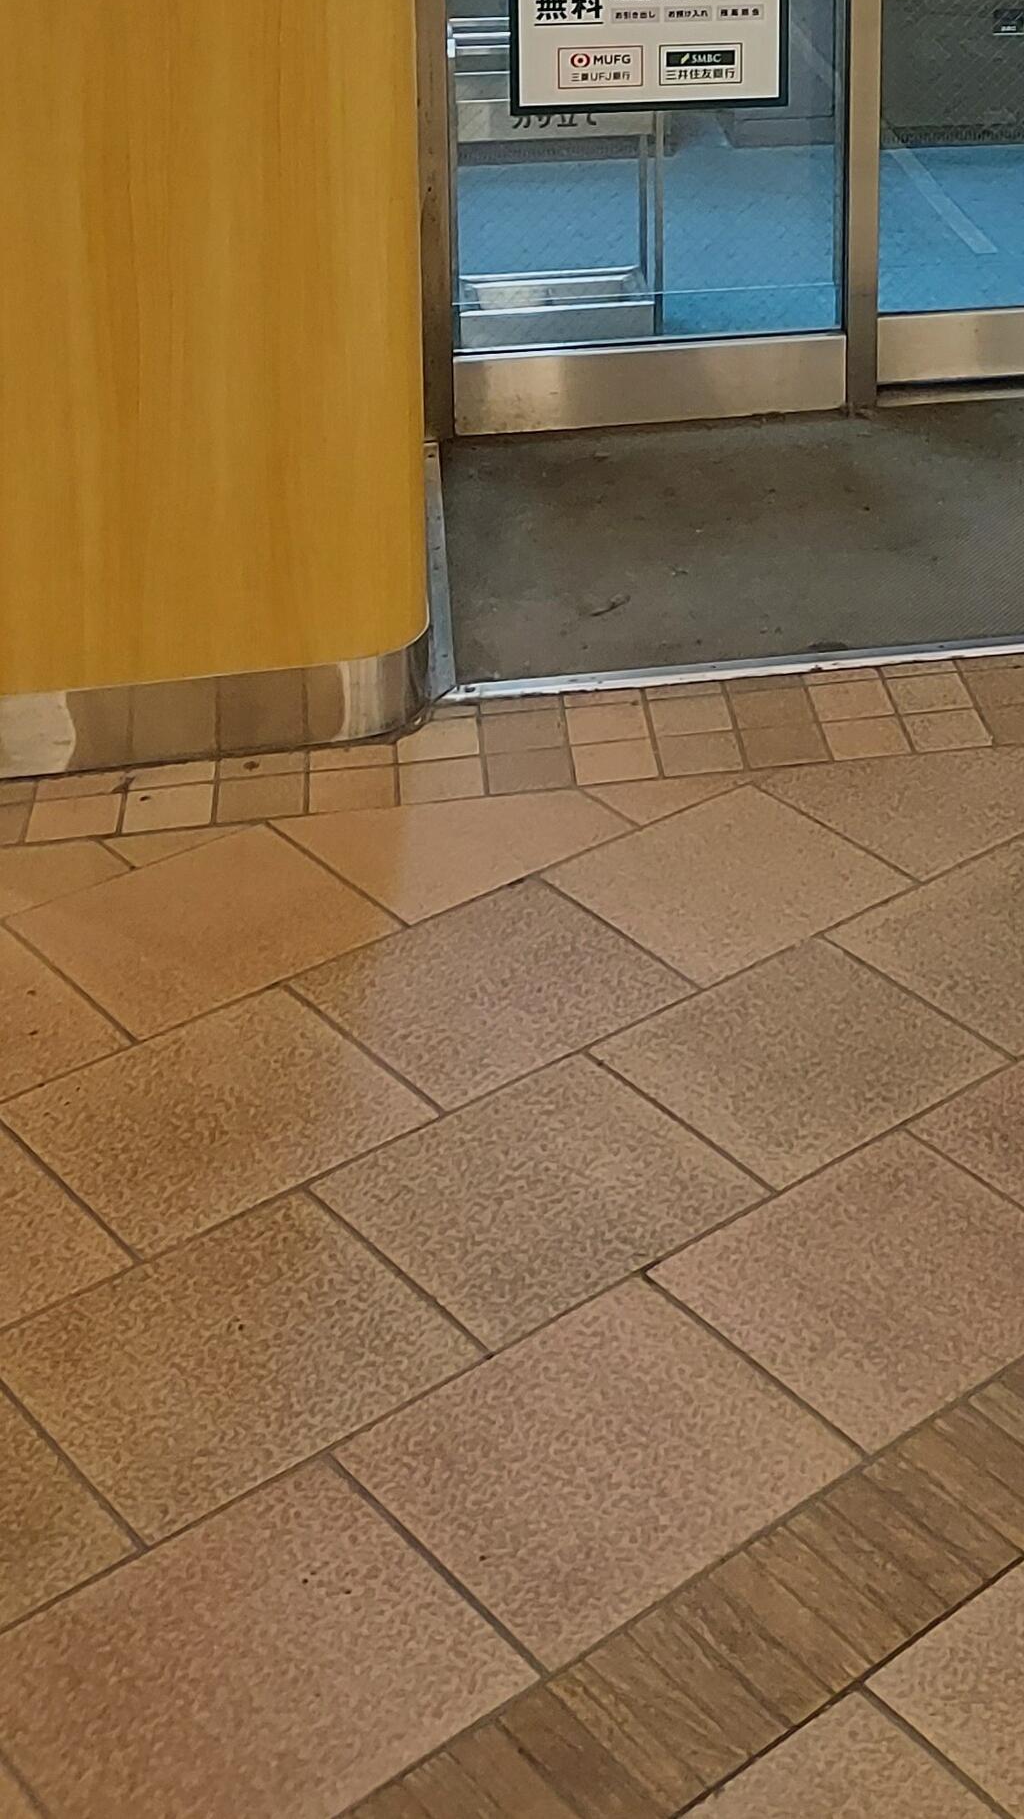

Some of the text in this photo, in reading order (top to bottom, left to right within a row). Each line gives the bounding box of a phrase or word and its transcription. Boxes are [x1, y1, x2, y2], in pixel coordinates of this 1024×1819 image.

[593, 54, 632, 66] MUFG
[691, 53, 723, 64] SMBC
[665, 67, 736, 81] 三井住友銀行
